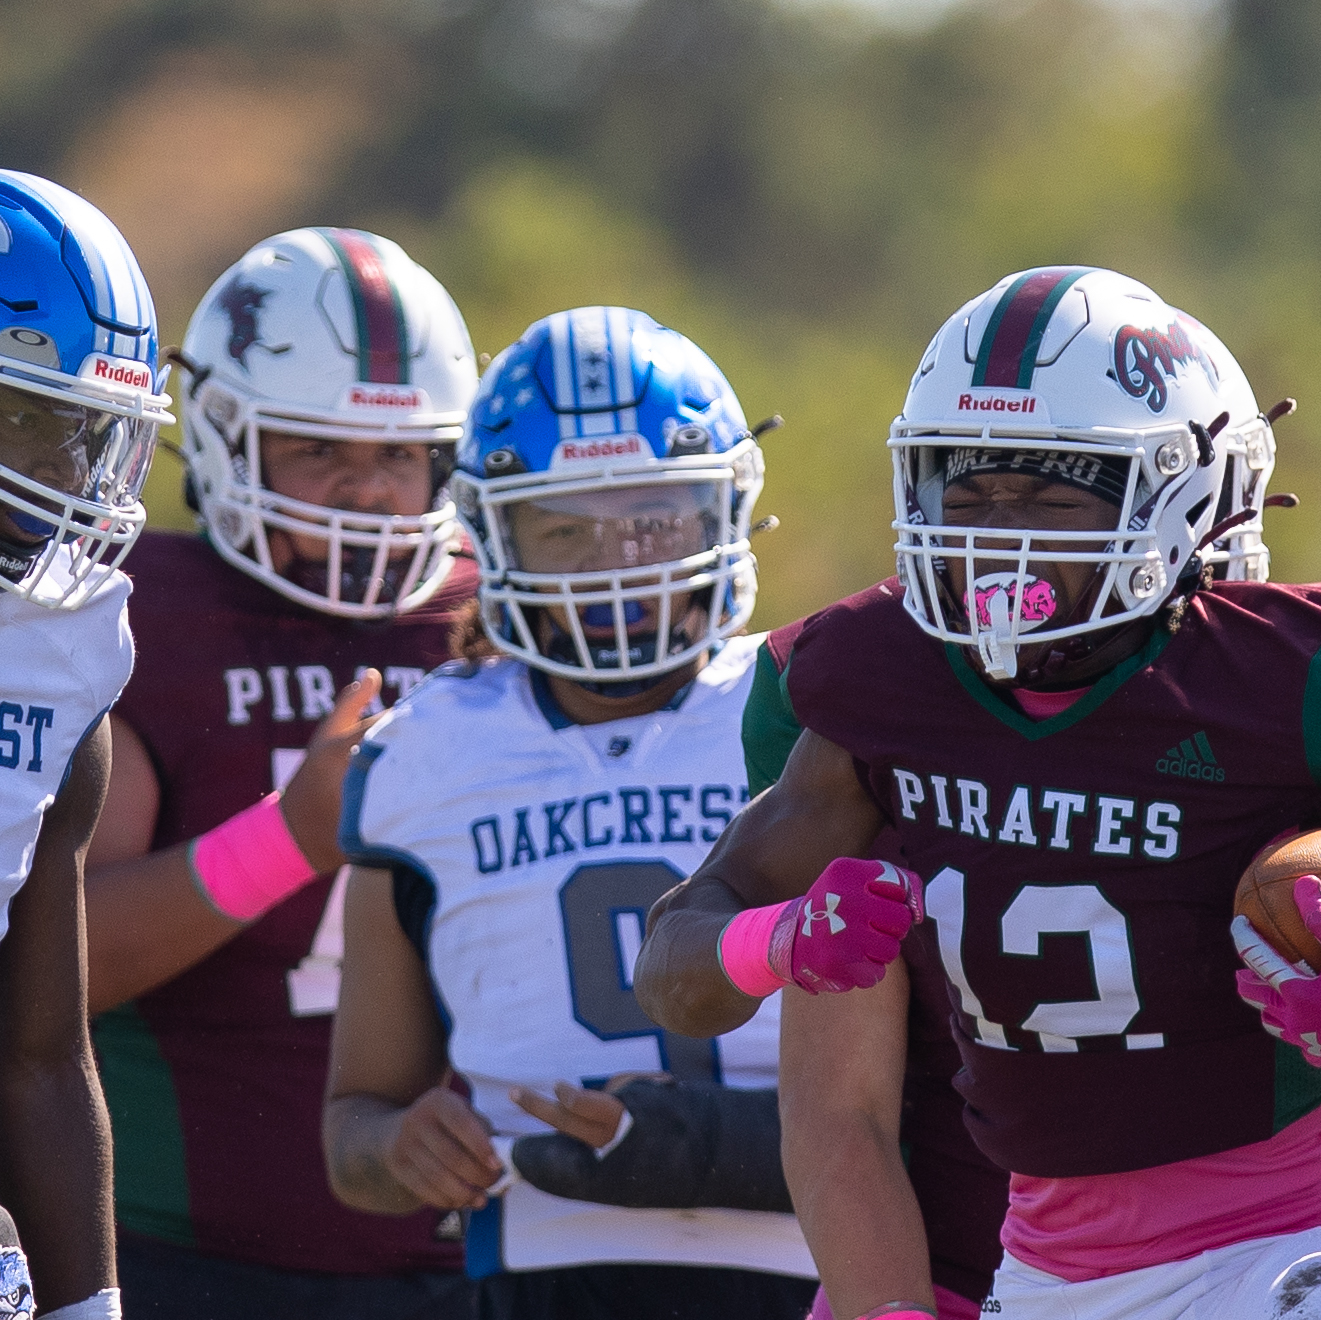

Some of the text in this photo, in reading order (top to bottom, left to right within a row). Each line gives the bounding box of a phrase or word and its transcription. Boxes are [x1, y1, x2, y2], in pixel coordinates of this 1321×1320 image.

[94, 358, 149, 388] Riddell
[958, 393, 1037, 413] Riddell
[561, 438, 641, 459] Riddell
[1155, 757, 1226, 782] adidas
[892, 765, 1183, 861] PIRATES
[471, 783, 750, 874] OAKCRES
[925, 864, 1166, 1053] 12
